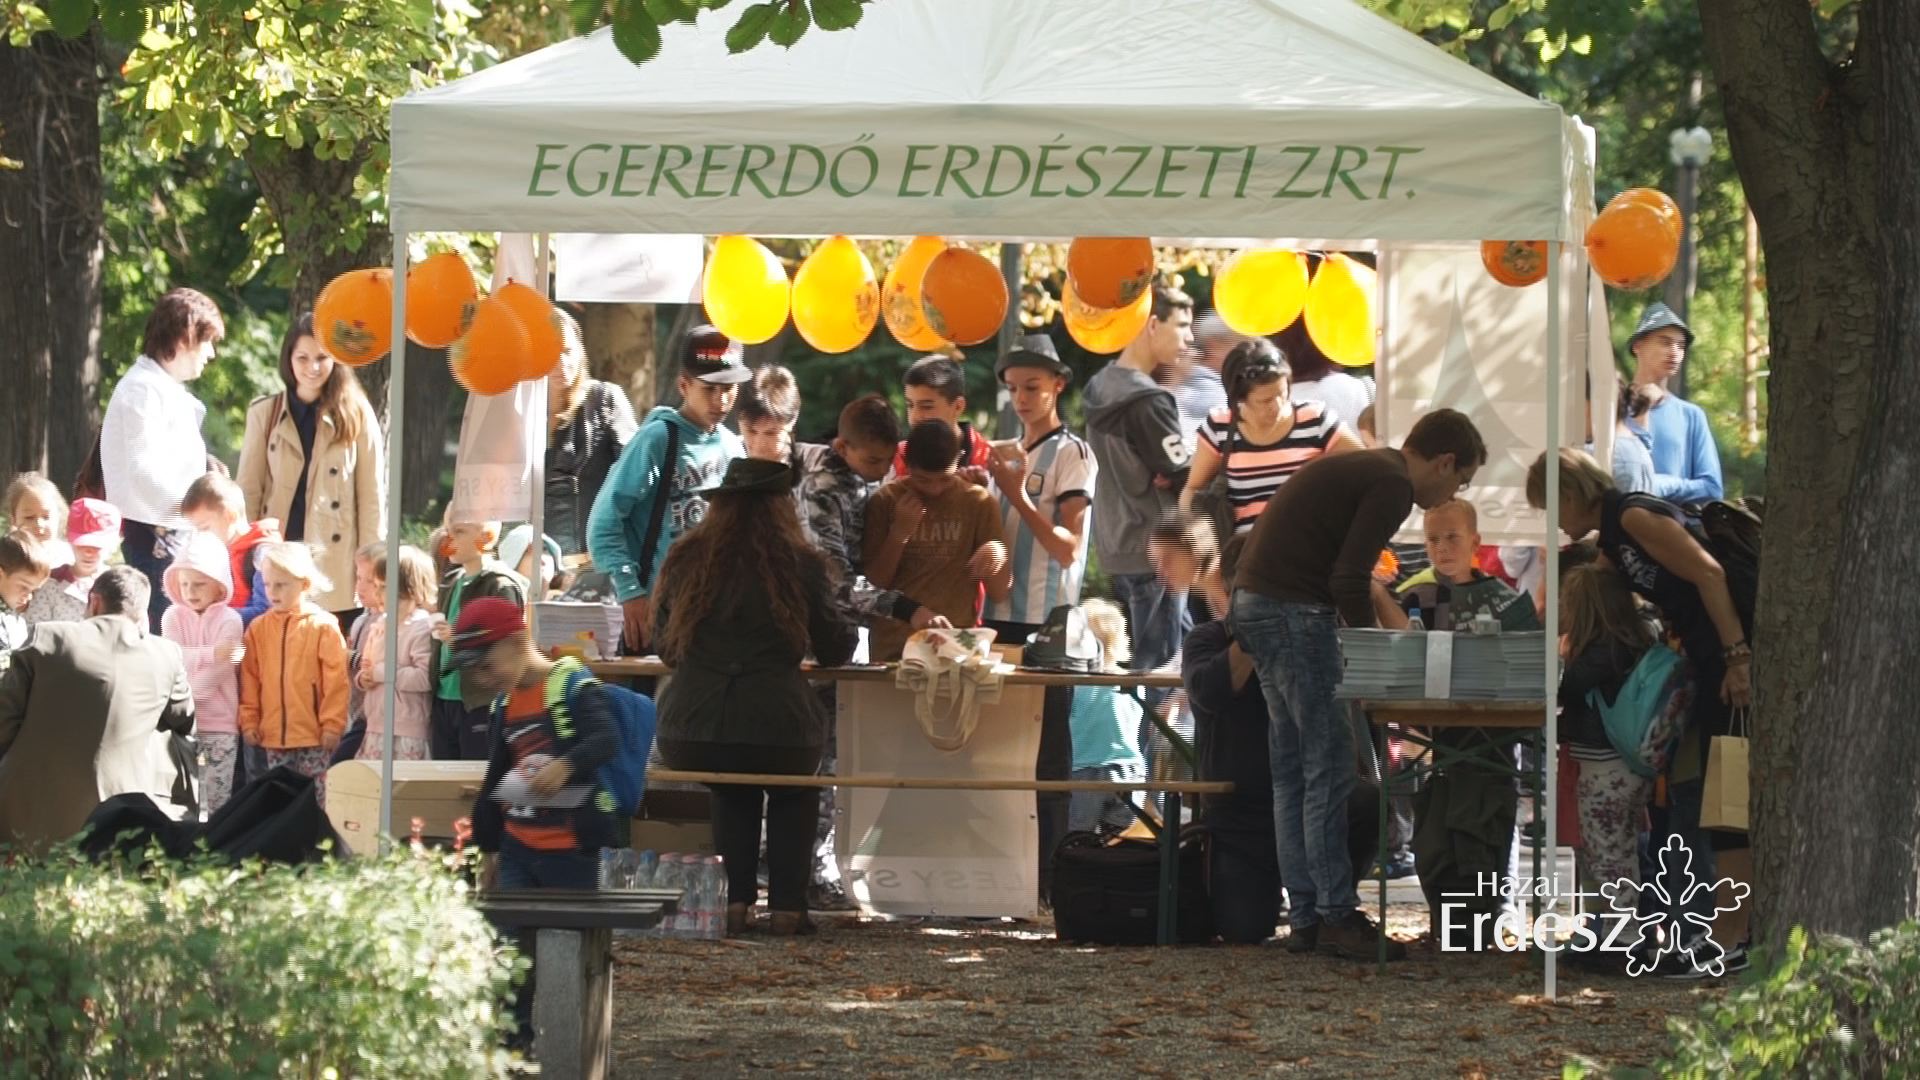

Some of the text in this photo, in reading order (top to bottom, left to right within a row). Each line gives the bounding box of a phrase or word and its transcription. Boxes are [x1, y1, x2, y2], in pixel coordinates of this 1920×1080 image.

[527, 133, 1425, 200] EGERERDŐ ERDÉSZETI ZRT.
